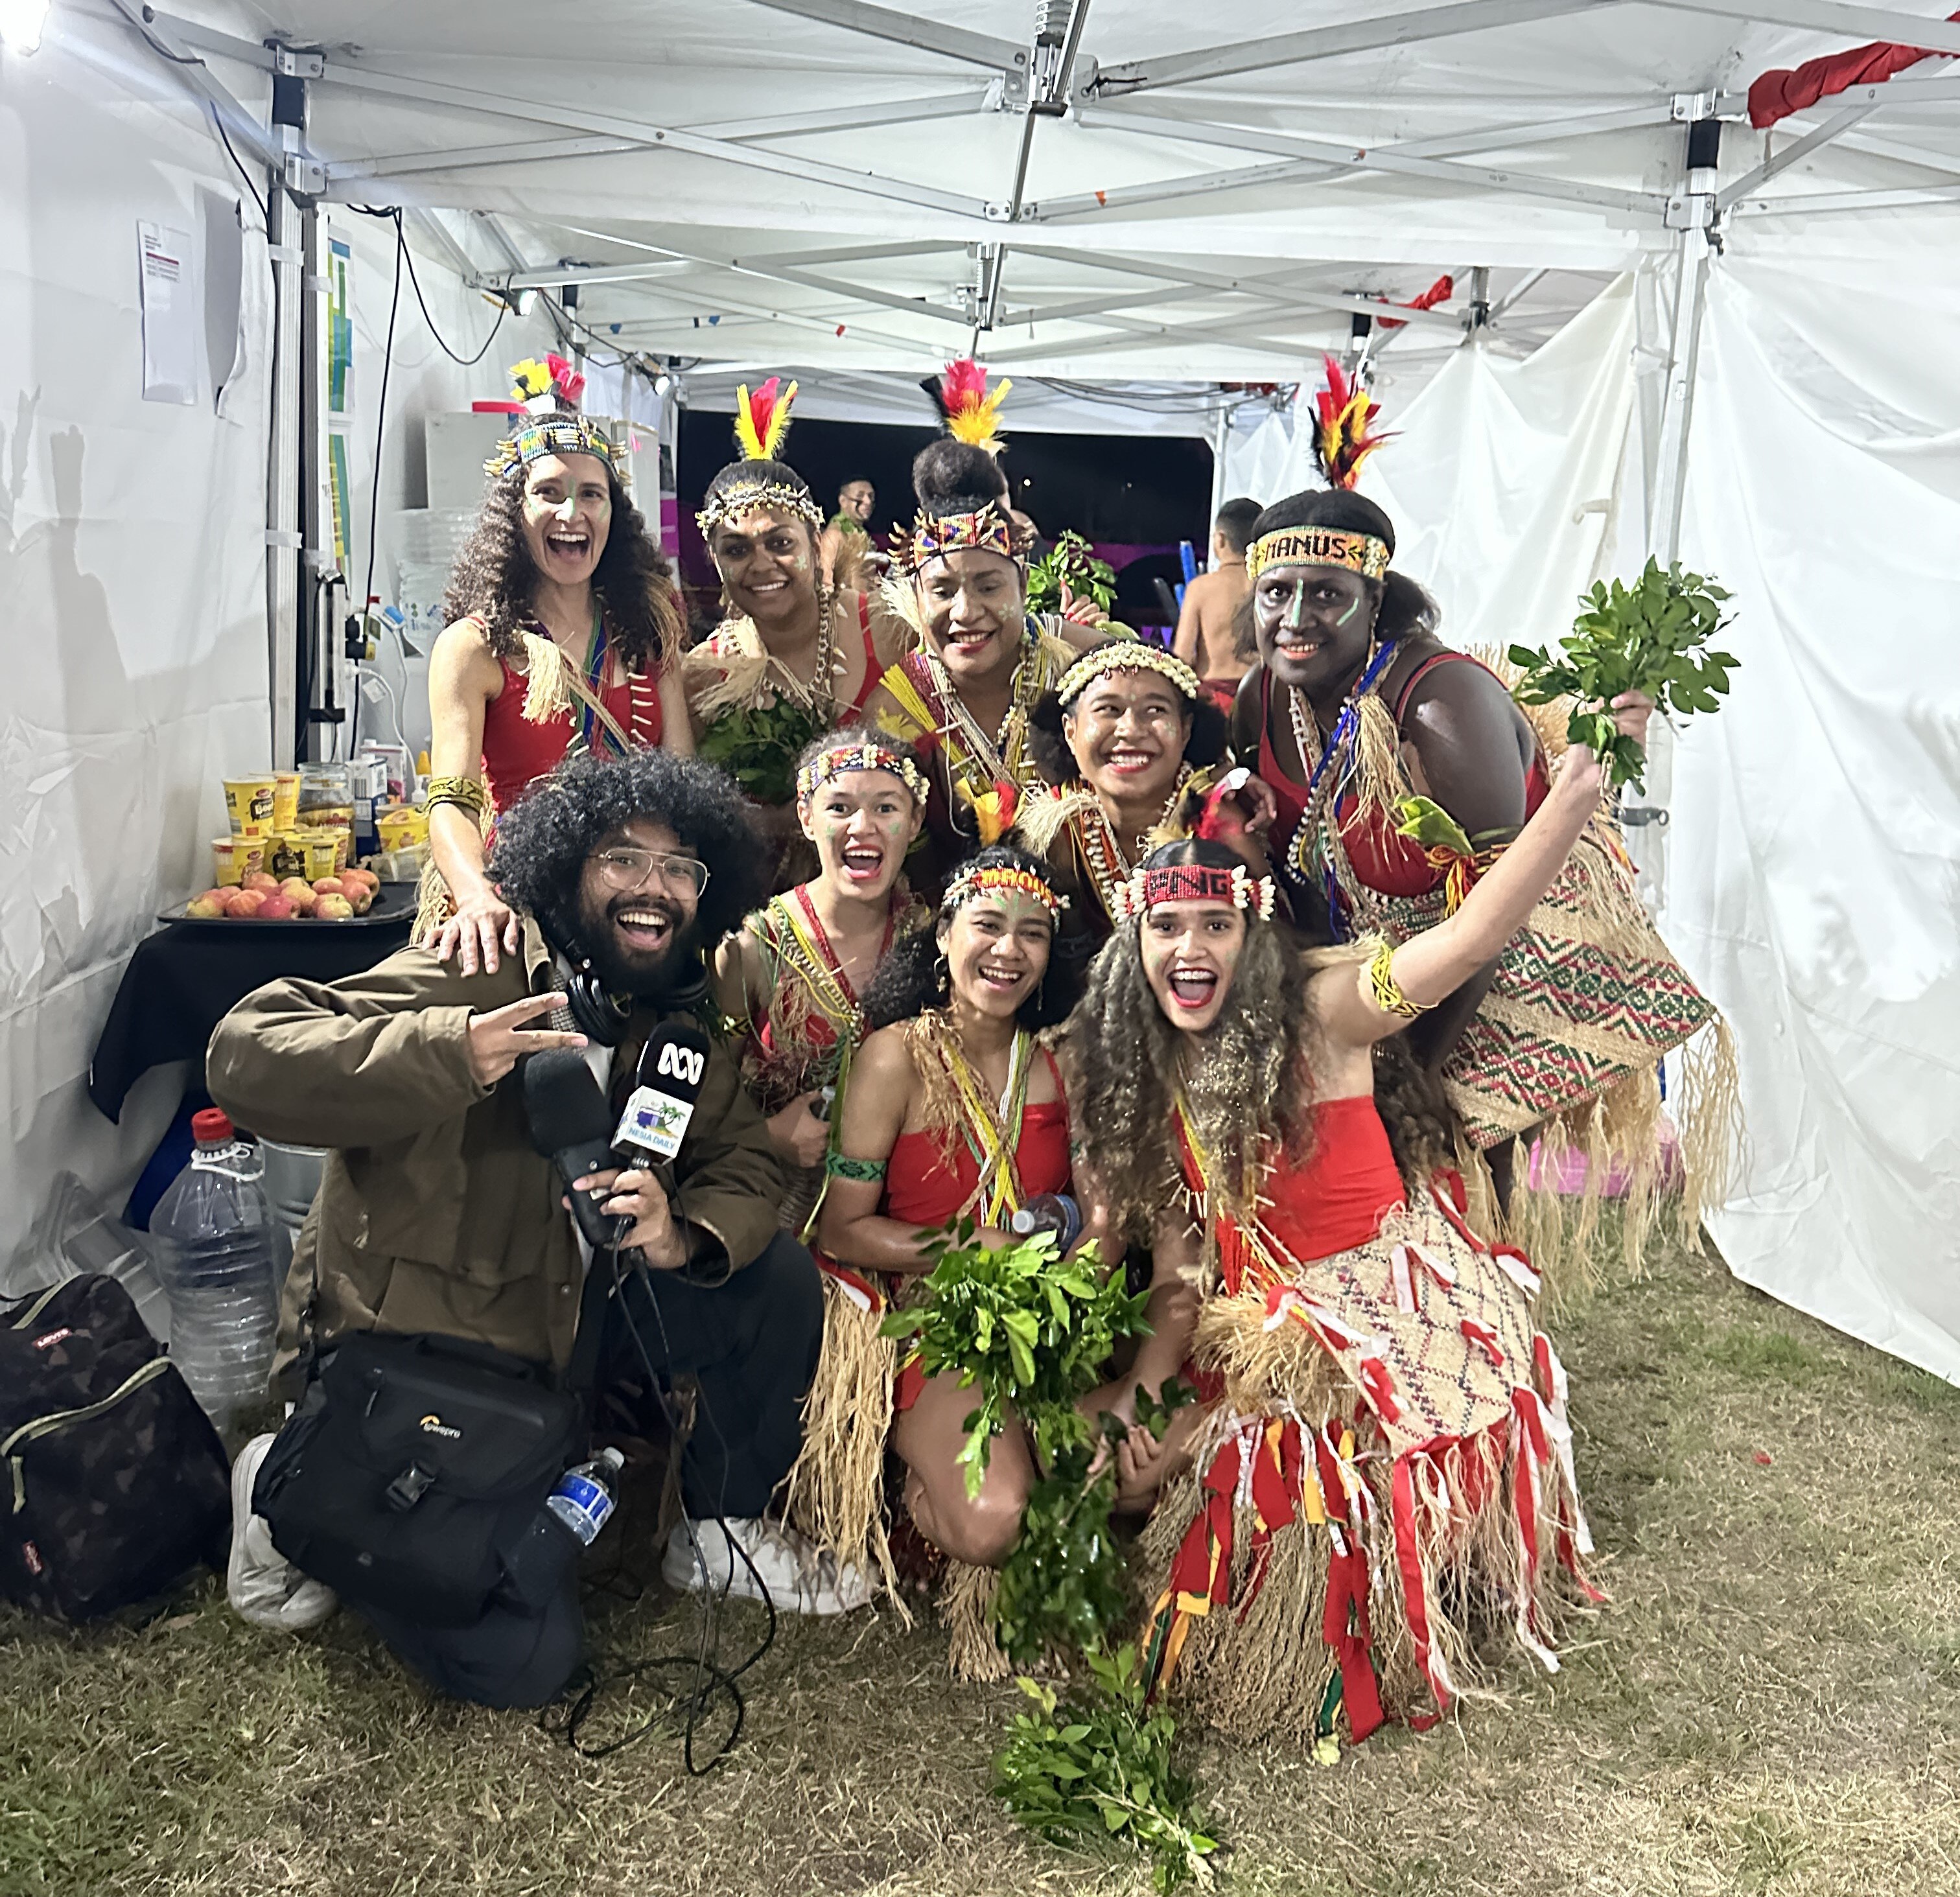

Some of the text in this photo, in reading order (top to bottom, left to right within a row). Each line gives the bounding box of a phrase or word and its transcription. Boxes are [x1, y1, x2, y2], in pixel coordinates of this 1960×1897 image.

[1265, 535, 1346, 562] MANUS
[1149, 871, 1228, 896] PNG
[629, 1126, 676, 1150] NESIA DAILY
